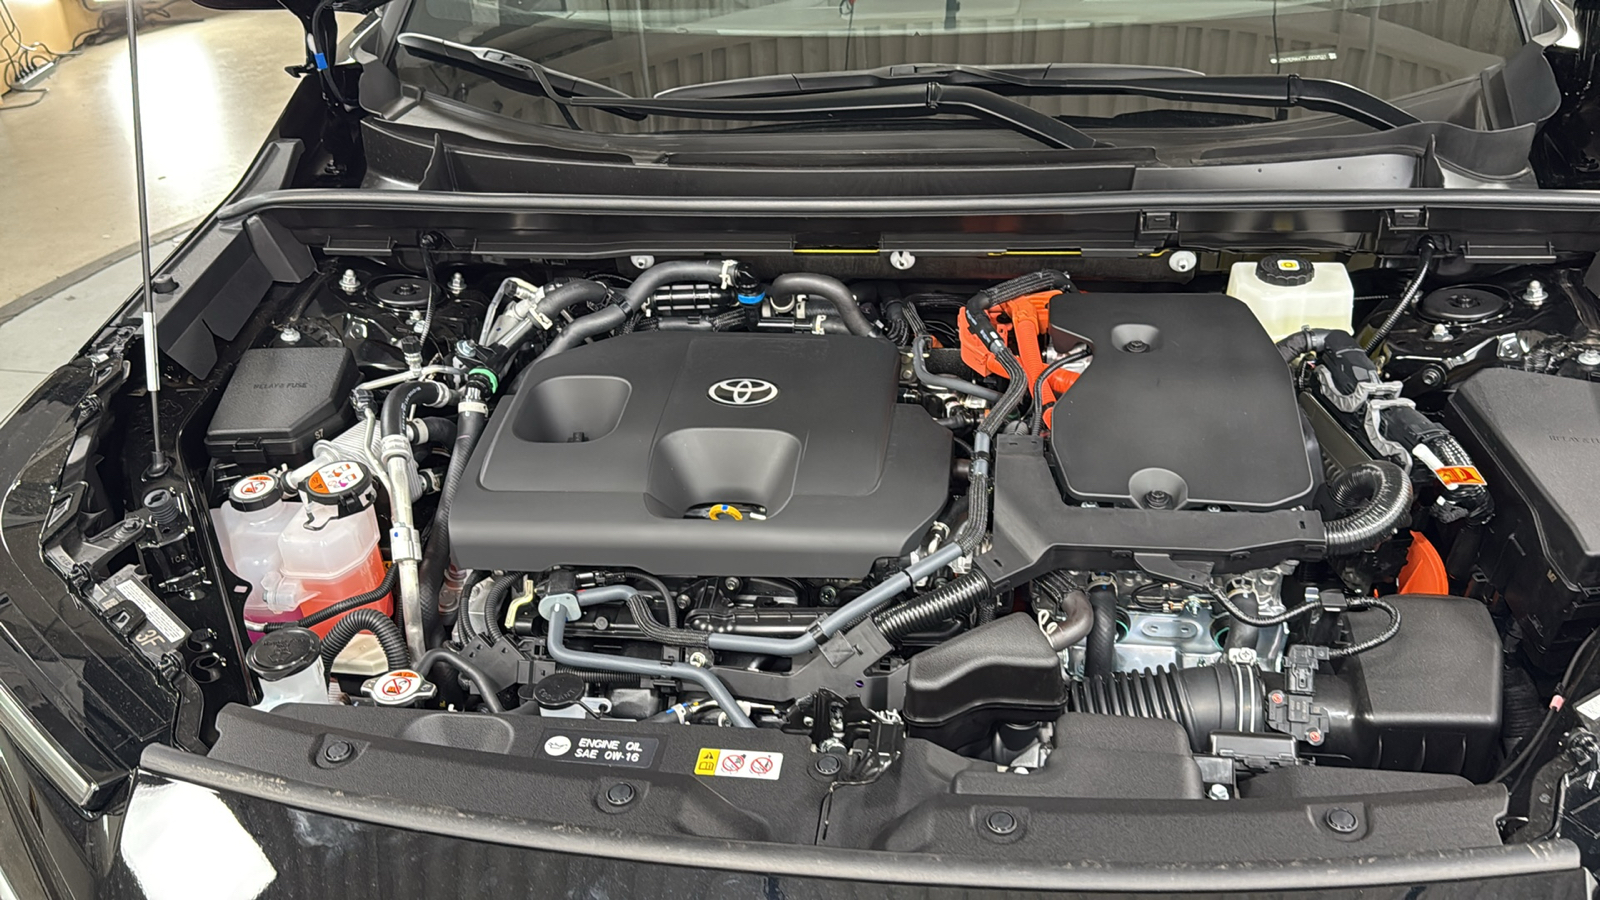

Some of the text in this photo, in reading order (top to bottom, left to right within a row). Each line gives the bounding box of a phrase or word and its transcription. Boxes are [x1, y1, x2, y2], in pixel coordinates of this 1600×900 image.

[135, 629, 166, 646] 3F
[578, 738, 643, 752] ENGINE OIL
[574, 748, 599, 759] SAE
